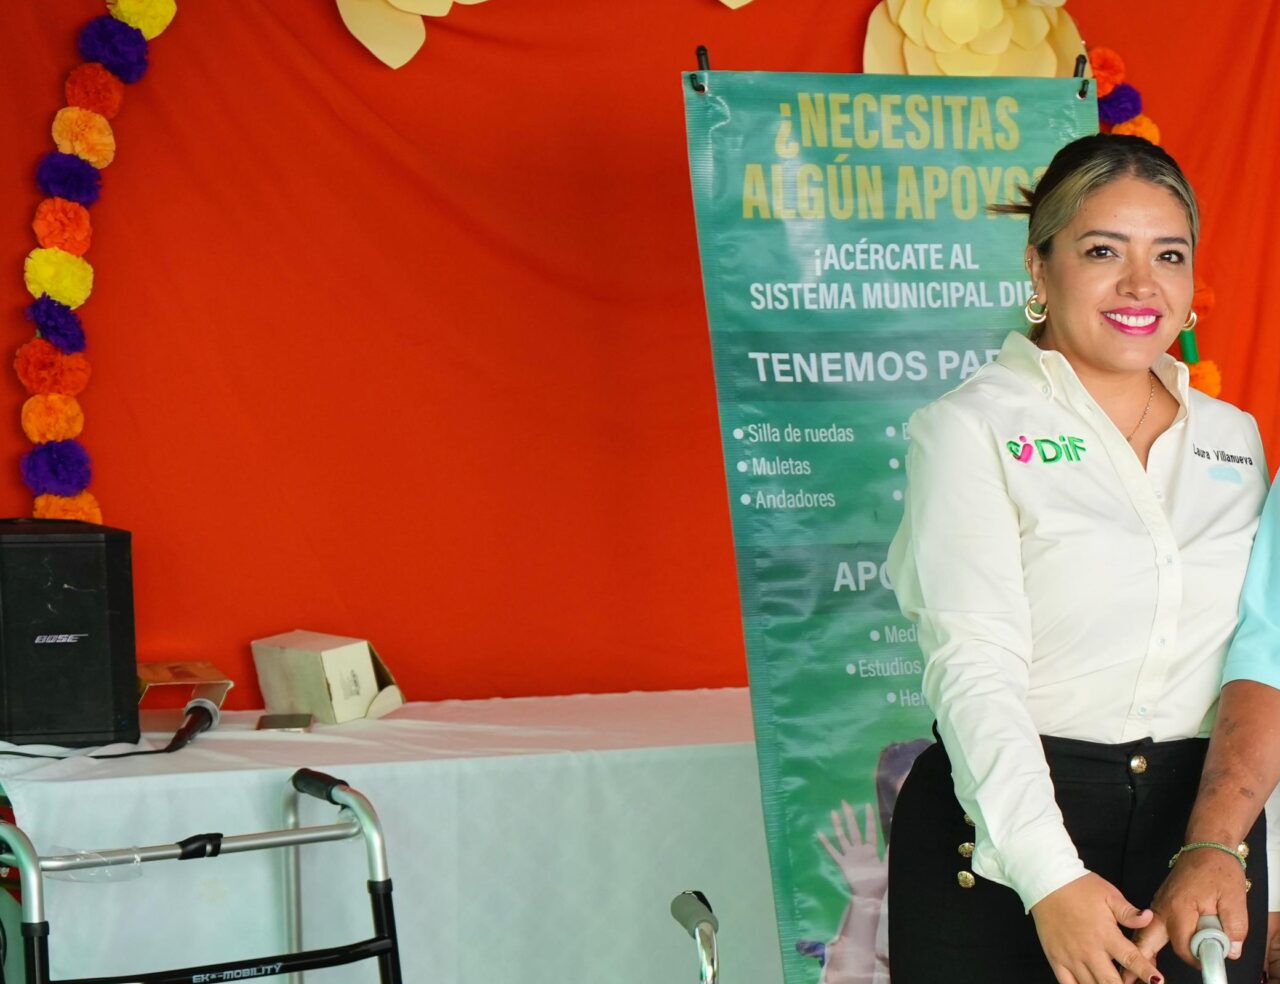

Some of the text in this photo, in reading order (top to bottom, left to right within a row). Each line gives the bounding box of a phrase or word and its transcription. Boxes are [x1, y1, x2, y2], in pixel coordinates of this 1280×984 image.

[775, 92, 1020, 158] ¿NECESITAS
[742, 153, 885, 220] ALGÚN
[814, 238, 979, 277] ¡ACÉRCATE AL
[750, 282, 859, 310] SISTEMA
[863, 281, 994, 309] MUNICIPAL
[749, 351, 928, 383] TENEMOS
[749, 423, 854, 443] Silla de ruedas
[752, 456, 812, 475] Muletas
[1213, 448, 1255, 466] Villanueva
[755, 489, 836, 509] Andadores
[34, 633, 89, 644] BOSE
[859, 657, 922, 677] Estudios
